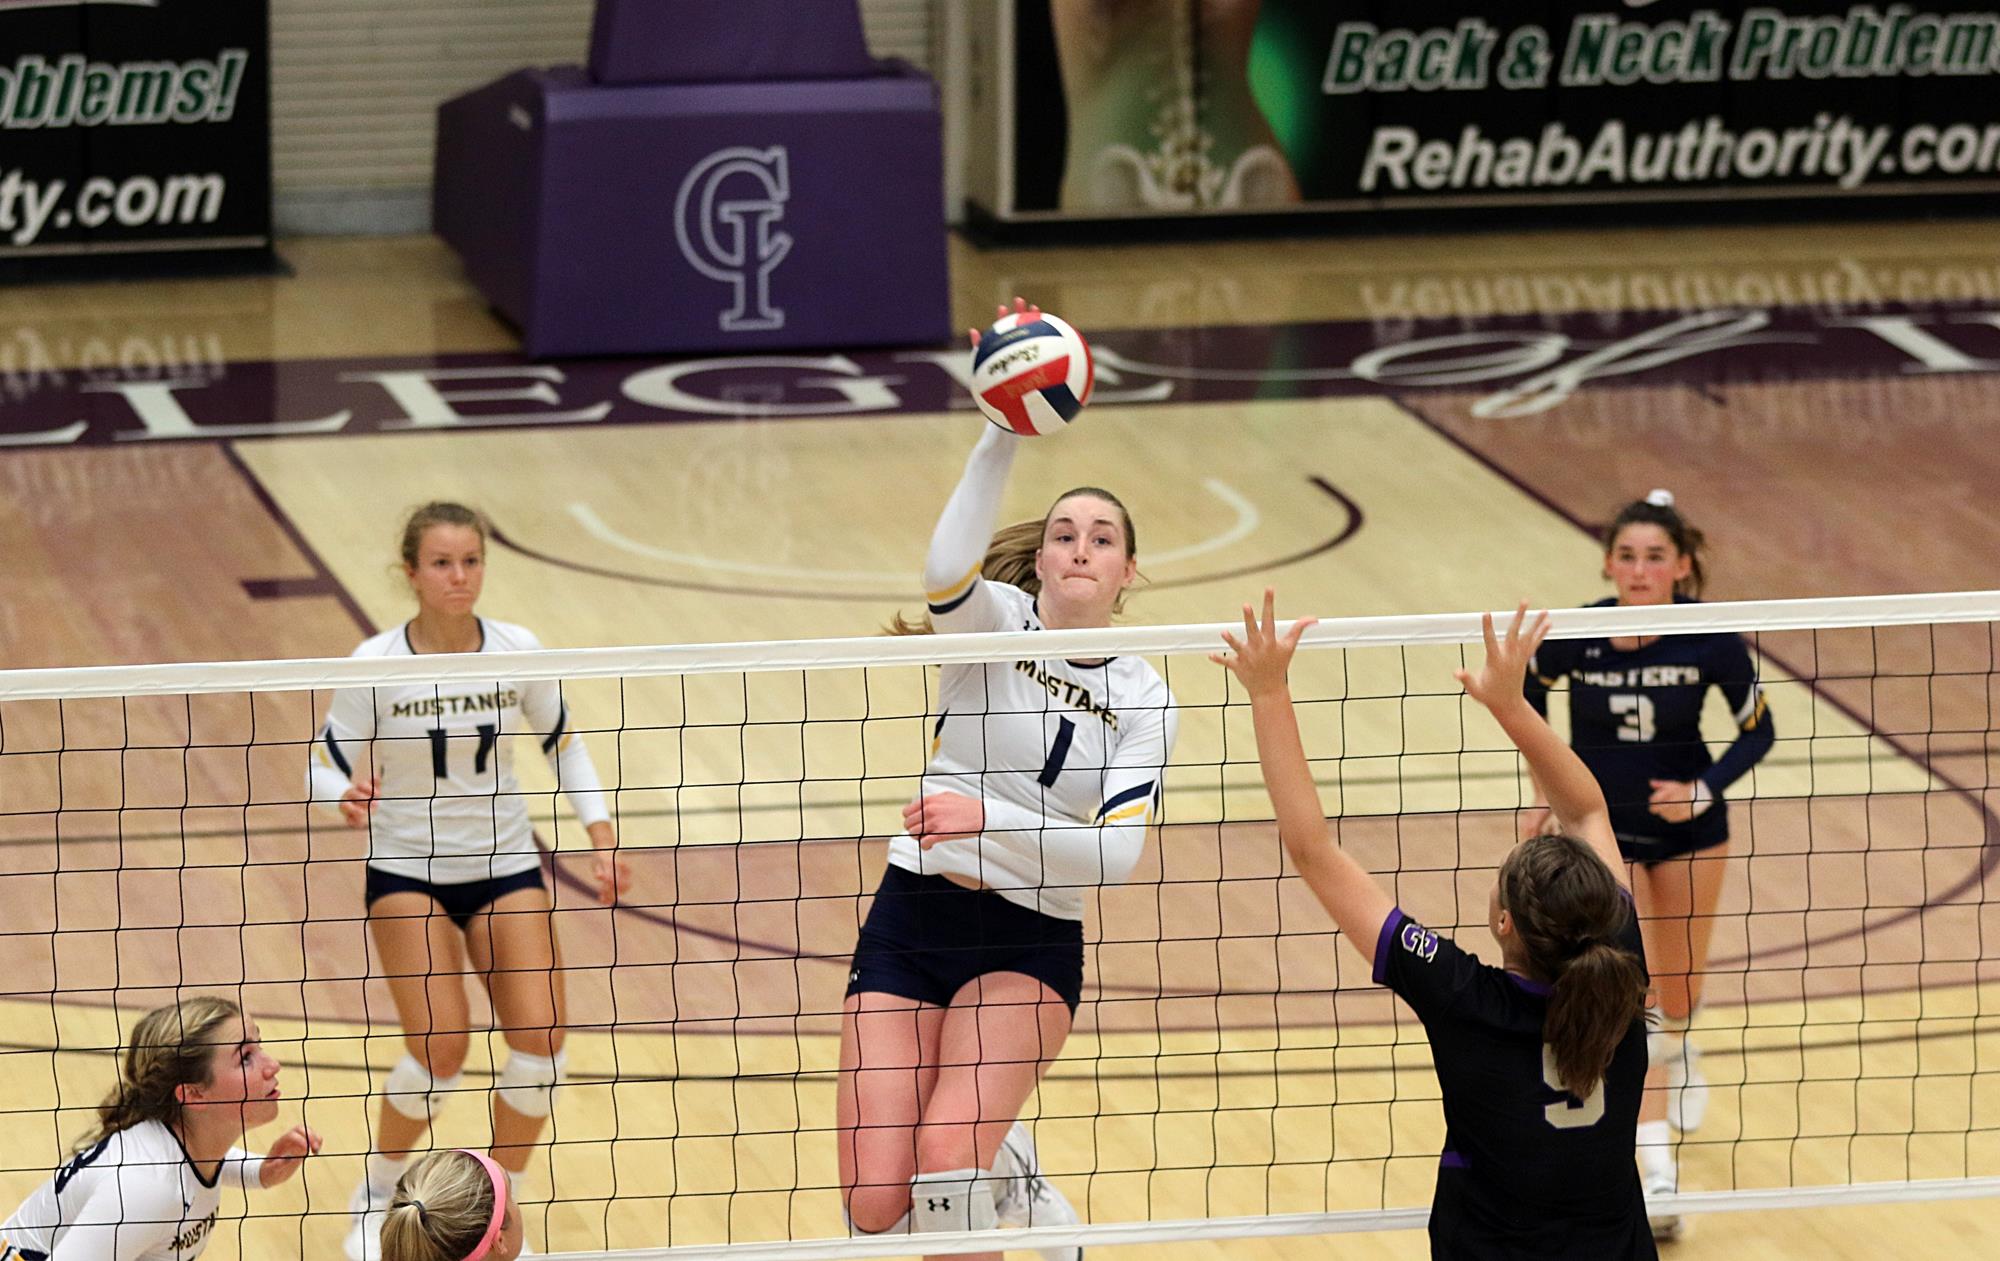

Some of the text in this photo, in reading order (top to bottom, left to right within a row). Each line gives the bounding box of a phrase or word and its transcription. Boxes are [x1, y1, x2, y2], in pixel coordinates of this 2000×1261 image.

[1322, 4, 2000, 94] Back & Neck Problem
[391, 690, 518, 717] MUSTANGS
[1608, 693, 1656, 742] 3
[1037, 714, 1076, 788] 1
